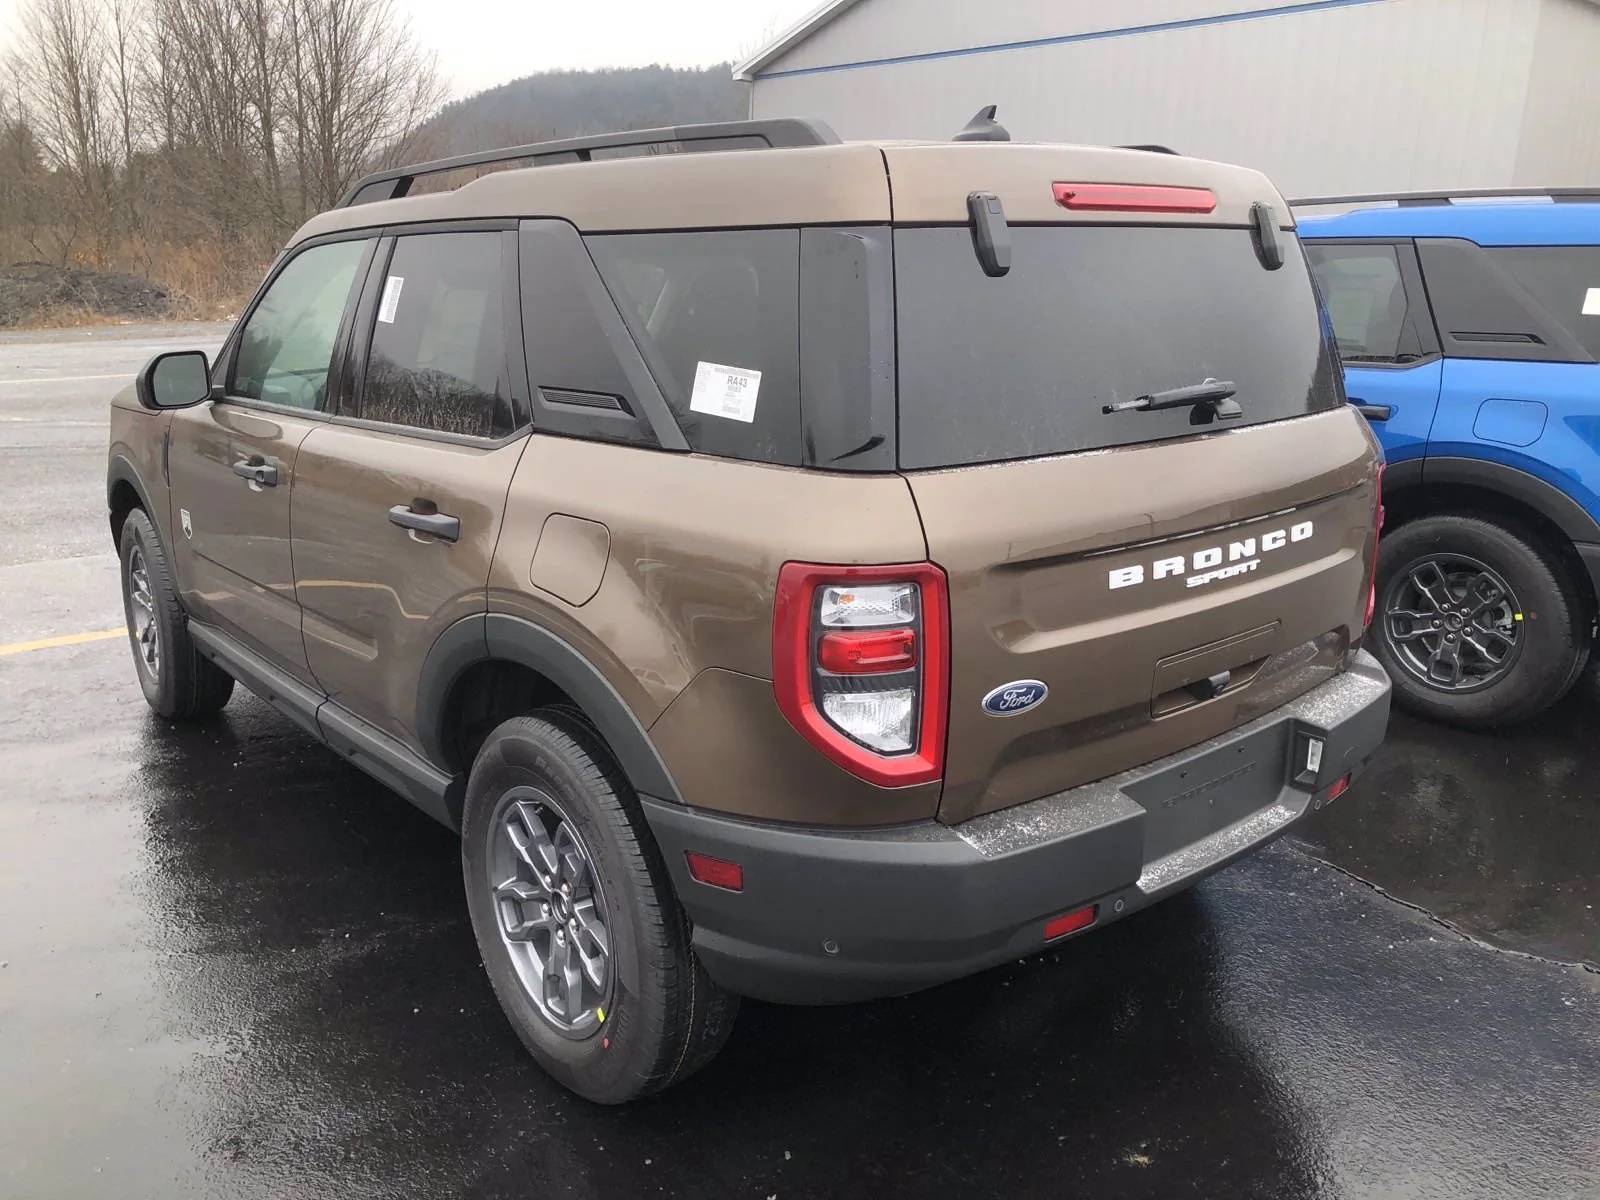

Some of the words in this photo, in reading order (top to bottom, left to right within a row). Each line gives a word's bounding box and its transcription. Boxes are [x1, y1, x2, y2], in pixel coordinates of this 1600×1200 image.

[726, 375, 748, 388] RA43
[1108, 520, 1313, 590] BRONCO
[1186, 559, 1261, 588] SPORT
[999, 687, 1035, 709] Ford
